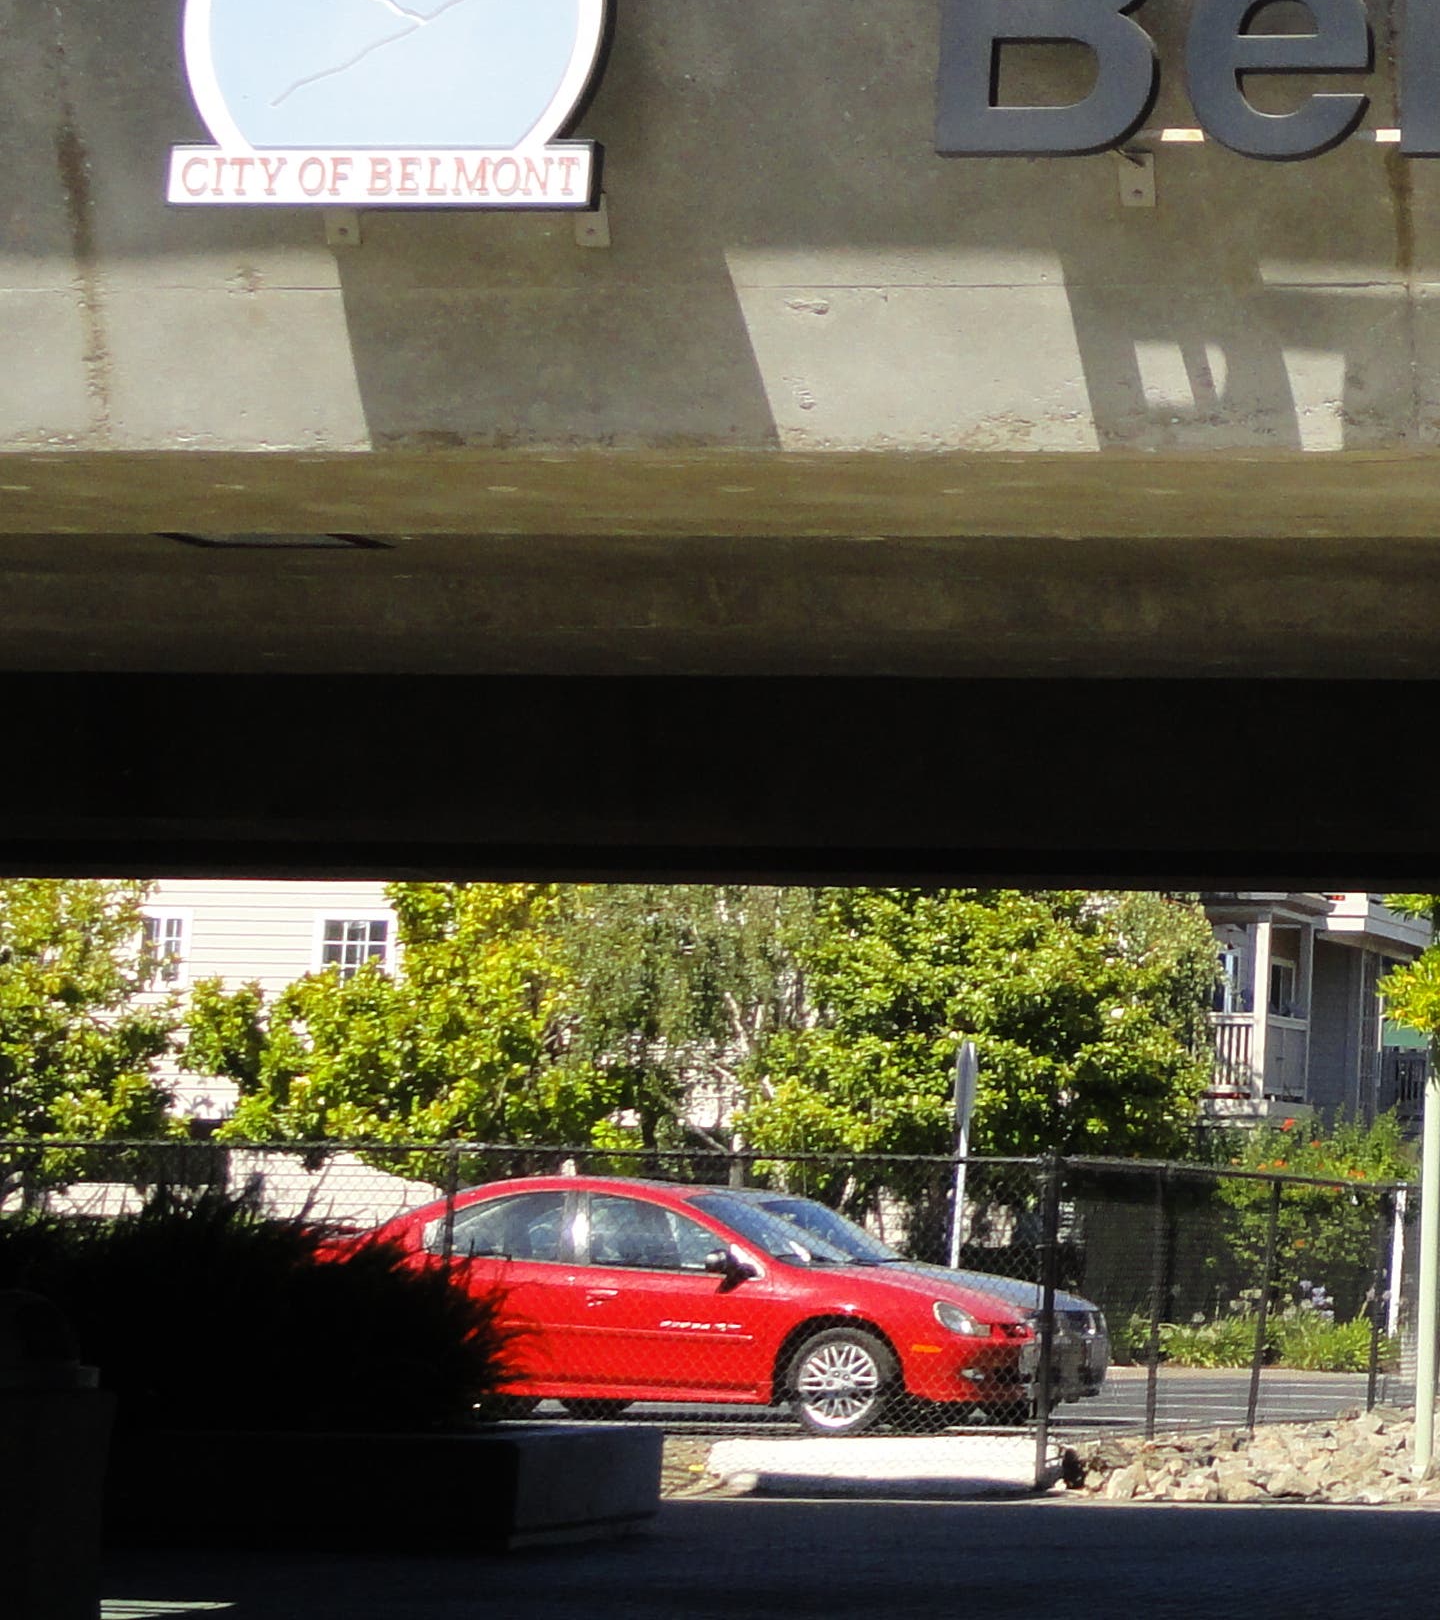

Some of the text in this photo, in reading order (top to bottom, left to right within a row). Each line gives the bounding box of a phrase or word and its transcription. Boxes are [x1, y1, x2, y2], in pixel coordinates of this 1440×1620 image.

[182, 157, 581, 197] CITY OF BELMONT
